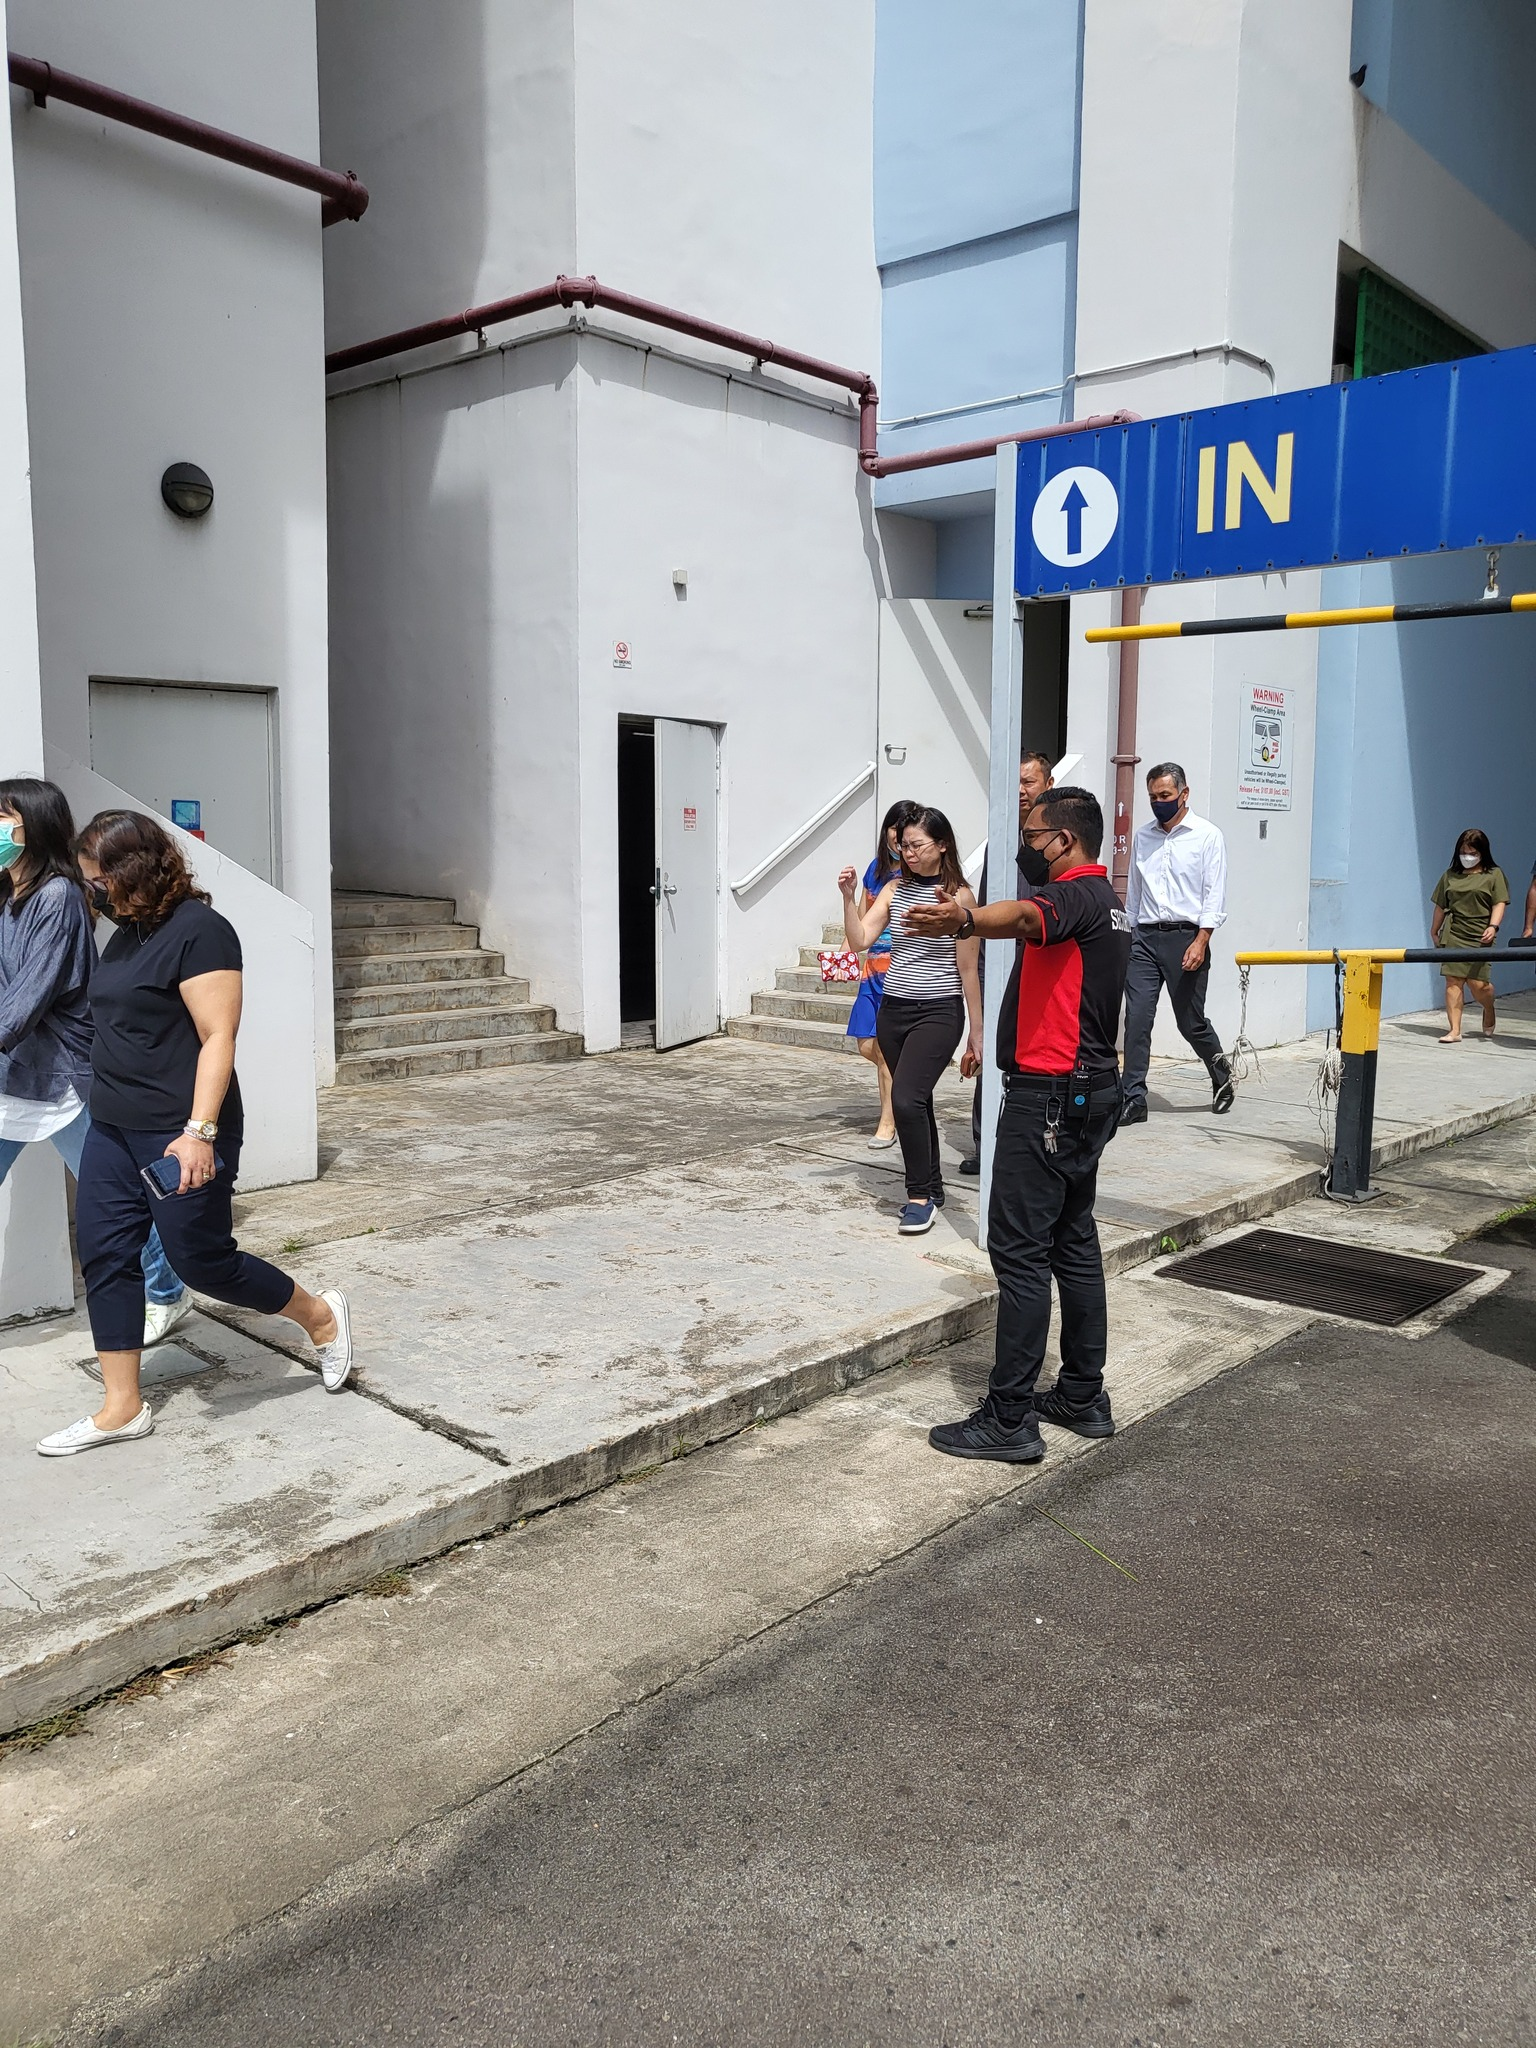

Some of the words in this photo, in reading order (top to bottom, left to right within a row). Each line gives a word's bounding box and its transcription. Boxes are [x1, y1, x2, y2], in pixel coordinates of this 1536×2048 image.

[1196, 432, 1294, 534] IN
[1253, 688, 1284, 704] WARNING
[1250, 704, 1276, 716] Wheel-Clamp
[1276, 709, 1286, 717] Area
[1239, 785, 1253, 793] Release
